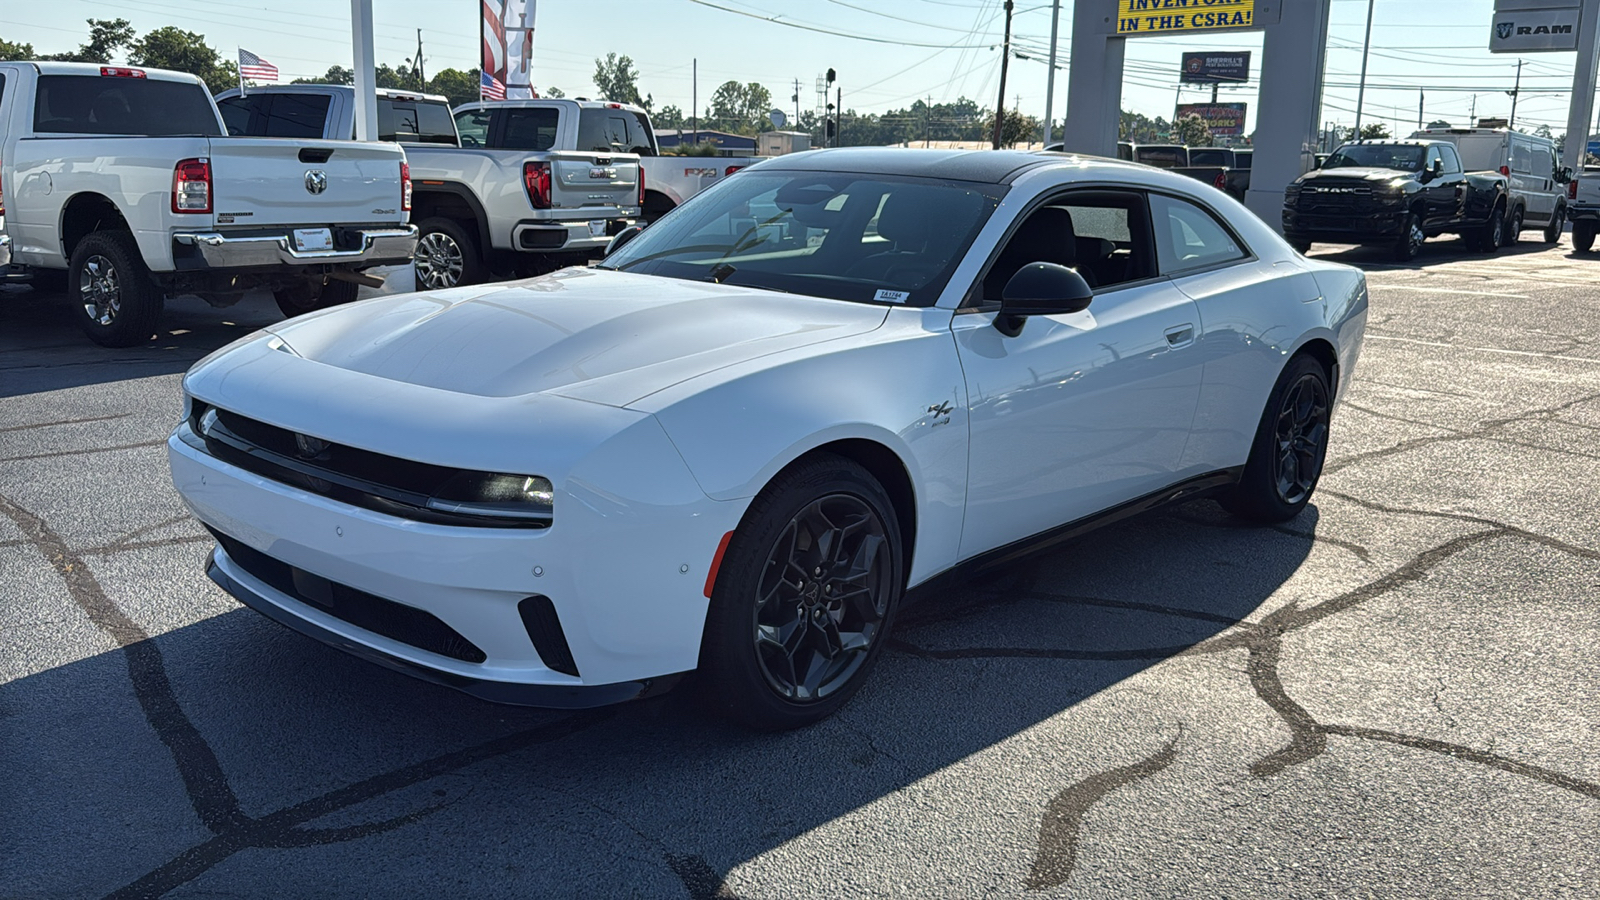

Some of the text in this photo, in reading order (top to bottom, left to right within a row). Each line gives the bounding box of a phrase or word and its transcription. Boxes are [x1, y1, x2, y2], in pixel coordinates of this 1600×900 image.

[1129, 0, 1242, 10] INVENT
[1119, 11, 1251, 31] IN THE CSRA!
[1517, 25, 1572, 35] RAM
[684, 168, 717, 177] FX4
